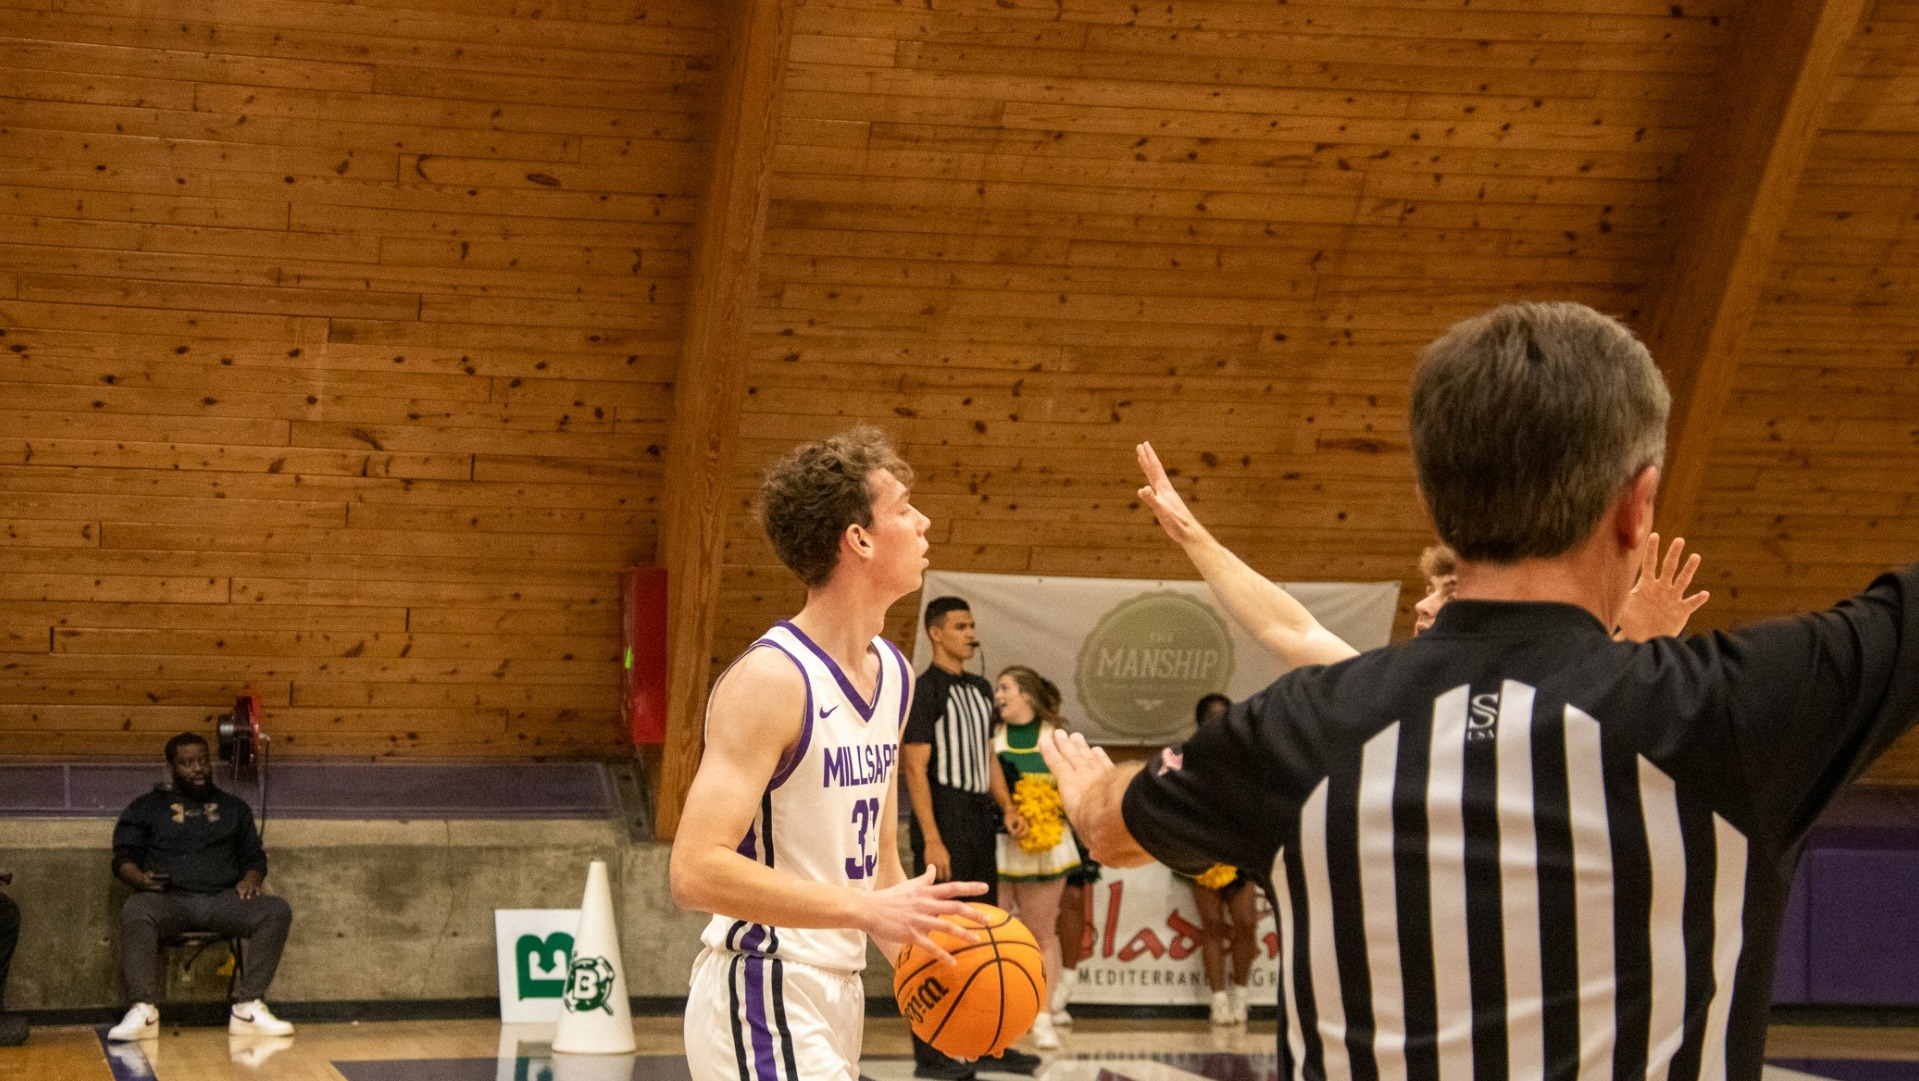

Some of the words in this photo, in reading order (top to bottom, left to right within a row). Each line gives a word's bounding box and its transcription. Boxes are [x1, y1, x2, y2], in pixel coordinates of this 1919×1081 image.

[1096, 647, 1219, 680] MANSHIP
[845, 797, 879, 880] 33
[516, 931, 574, 1002] B
[1077, 967, 1235, 987] MEDITERRAN
[572, 967, 600, 1000] B
